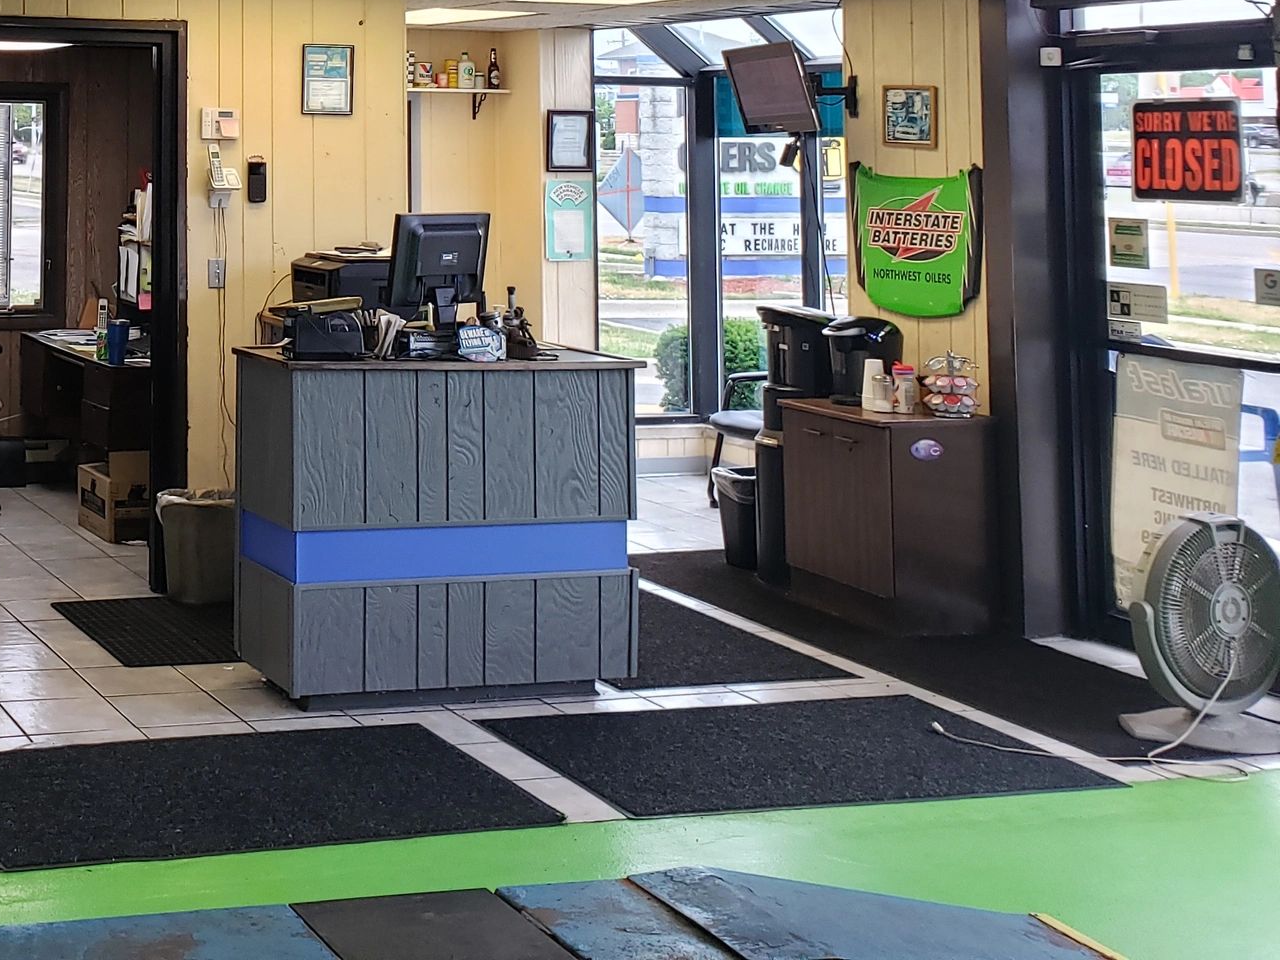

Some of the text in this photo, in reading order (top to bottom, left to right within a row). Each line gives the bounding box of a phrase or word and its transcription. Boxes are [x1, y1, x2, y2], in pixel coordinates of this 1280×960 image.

[1136, 111, 1237, 132] SORRY WE'RE
[1136, 138, 1240, 192] CLOSED
[734, 182, 748, 195] OIL
[754, 182, 793, 196] CHANGE
[751, 223, 775, 235] THE
[869, 211, 961, 230] INTERSTATE
[744, 239, 837, 251] RECHARGE RE
[871, 231, 955, 250] BATTERIES
[873, 268, 951, 285] NORTHWEST OILERS
